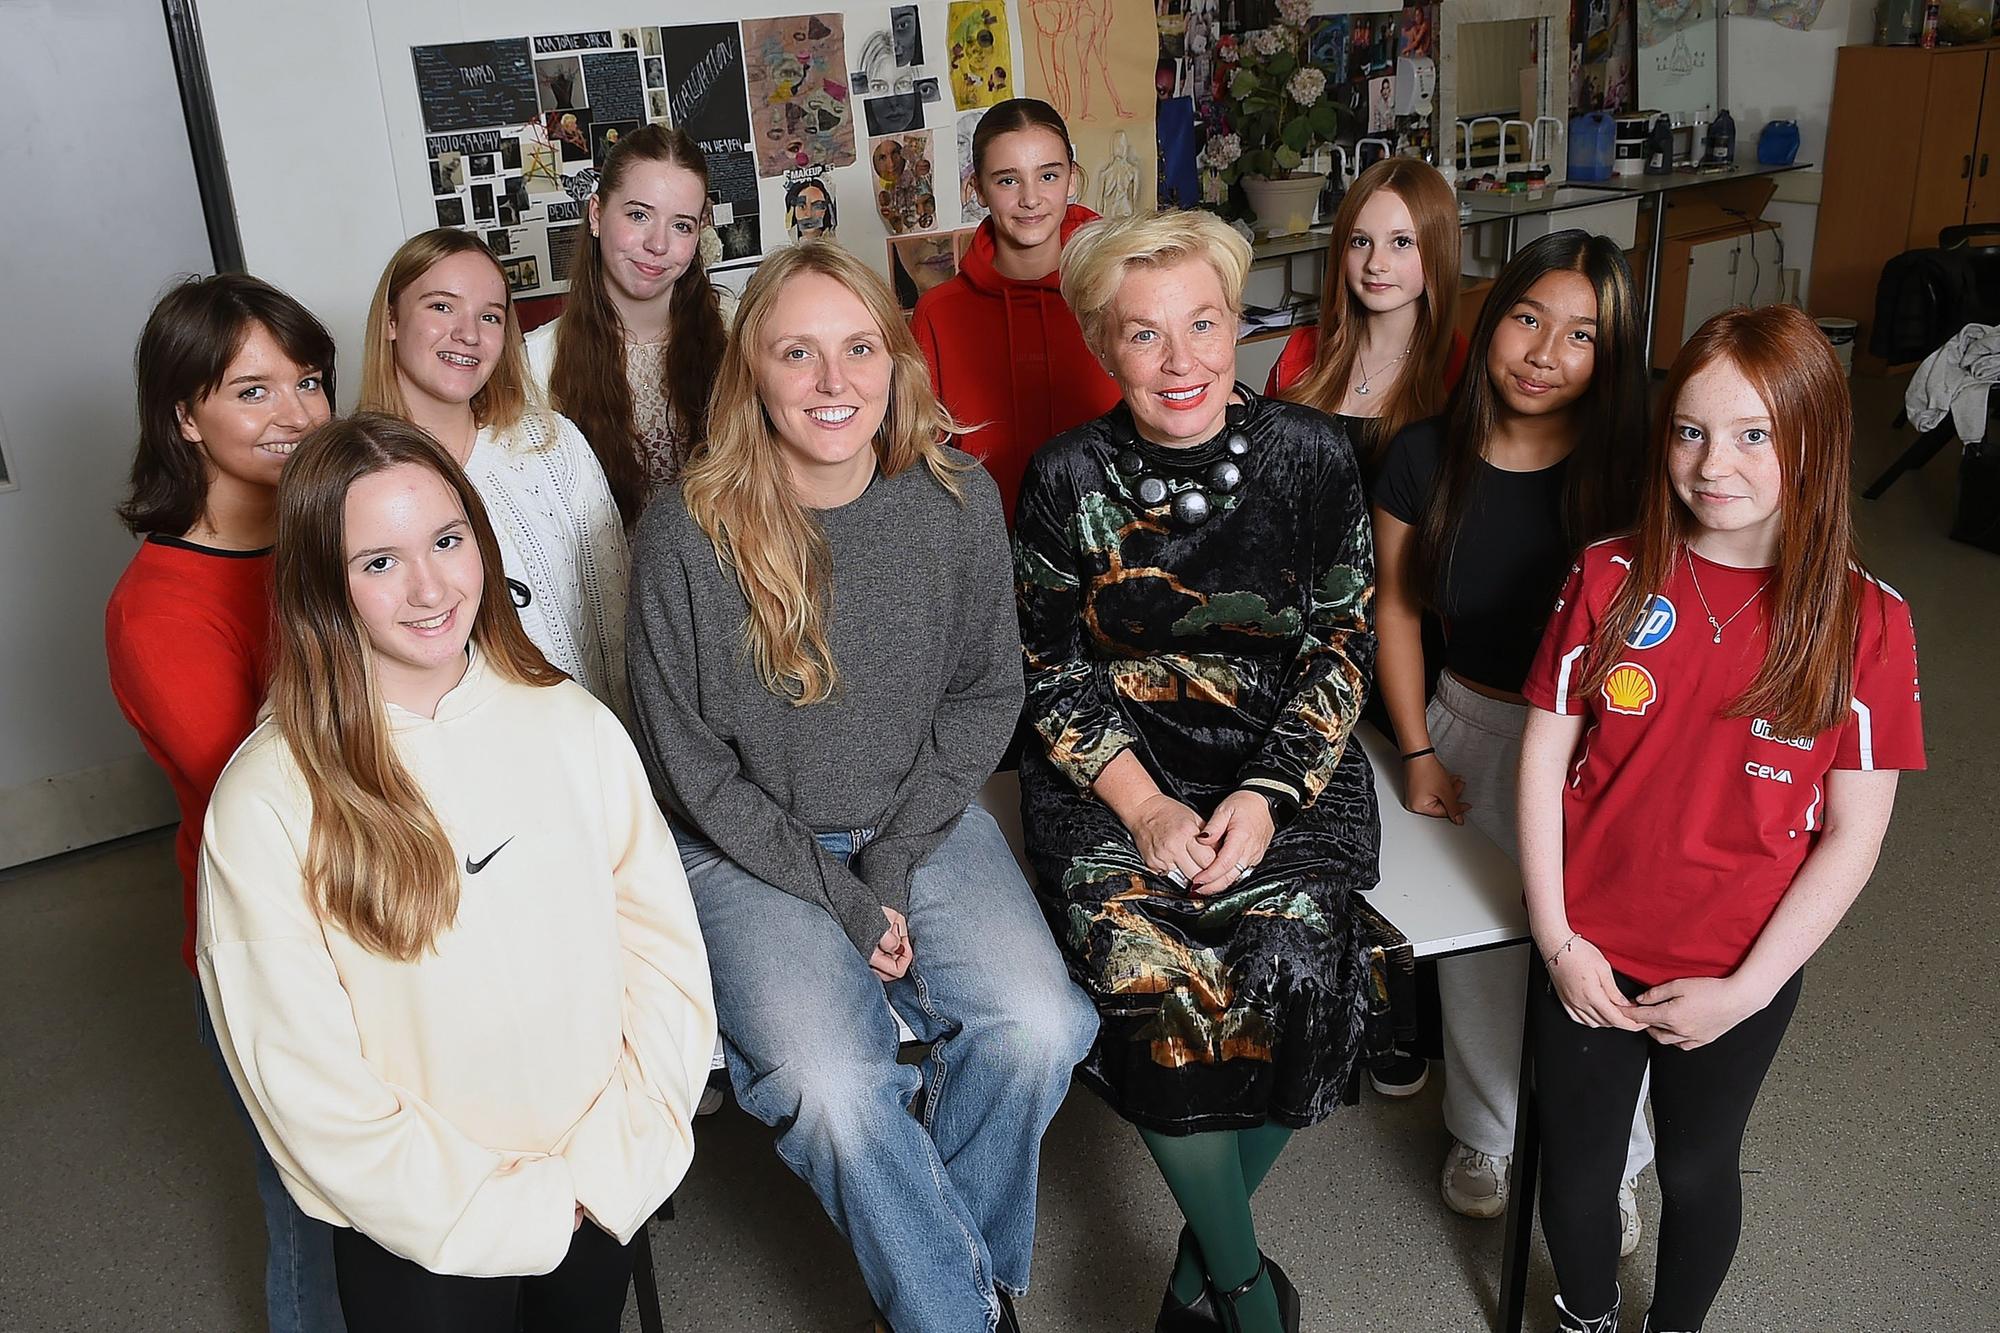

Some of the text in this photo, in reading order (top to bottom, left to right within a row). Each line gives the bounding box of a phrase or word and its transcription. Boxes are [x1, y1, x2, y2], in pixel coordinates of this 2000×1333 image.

[459, 65, 496, 87] TRAPPED
[672, 36, 734, 124] EVALUATION
[428, 132, 500, 156] PHOTOGRAPHY
[791, 166, 822, 180] MAKEUP
